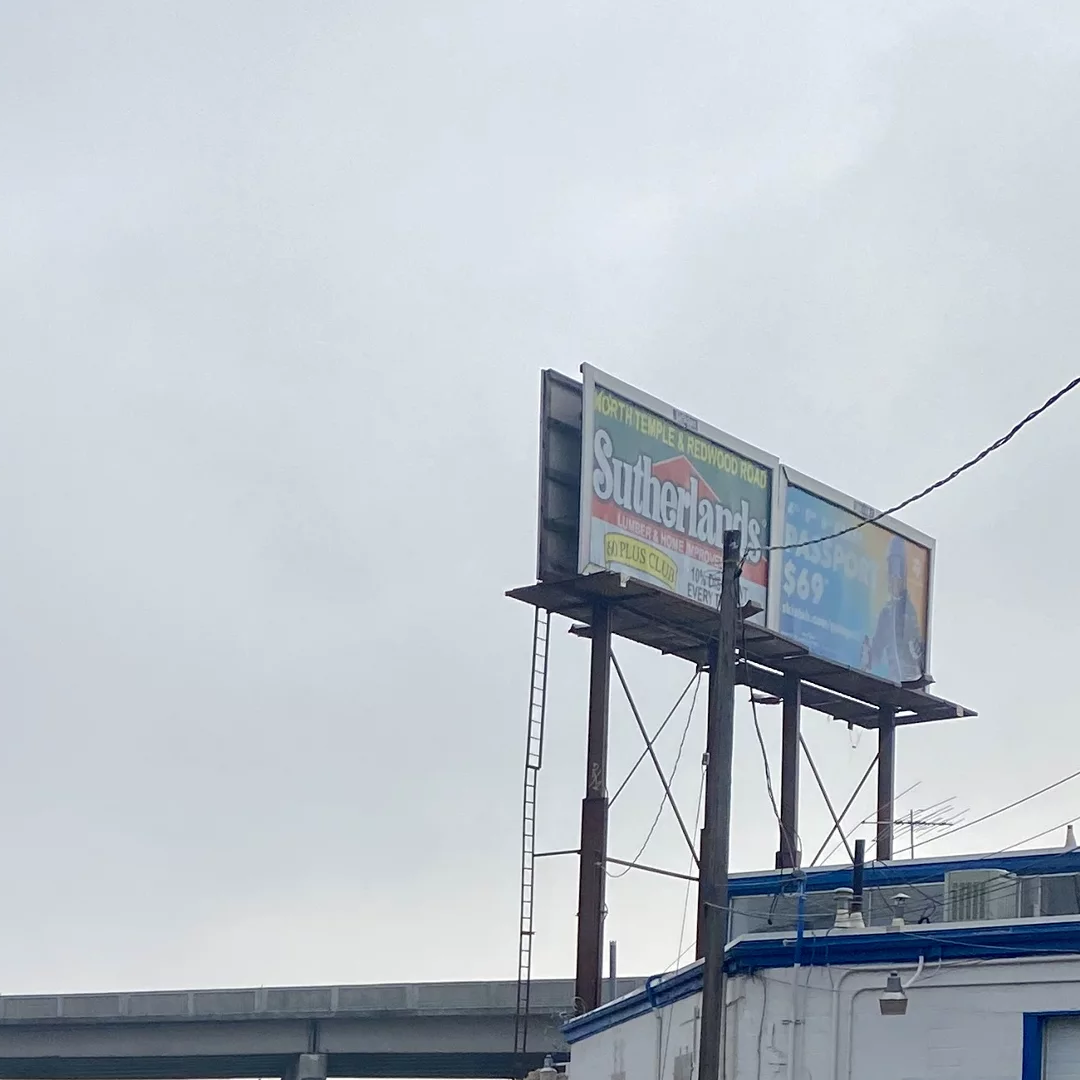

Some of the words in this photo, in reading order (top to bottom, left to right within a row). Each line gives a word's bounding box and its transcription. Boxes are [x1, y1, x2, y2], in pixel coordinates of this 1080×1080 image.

[635, 412, 675, 447] TEMPLE
[677, 431, 685, 453] &
[687, 435, 738, 476] REDWOOD
[740, 458, 767, 489] ROAD
[593, 429, 763, 564] Sutherlands
[617, 513, 652, 539] LUMBER
[652, 526, 659, 540] &
[661, 529, 685, 553] HOME
[619, 541, 646, 564] PLUS
[648, 551, 675, 583] CLUB
[688, 583, 712, 605] EVERY
